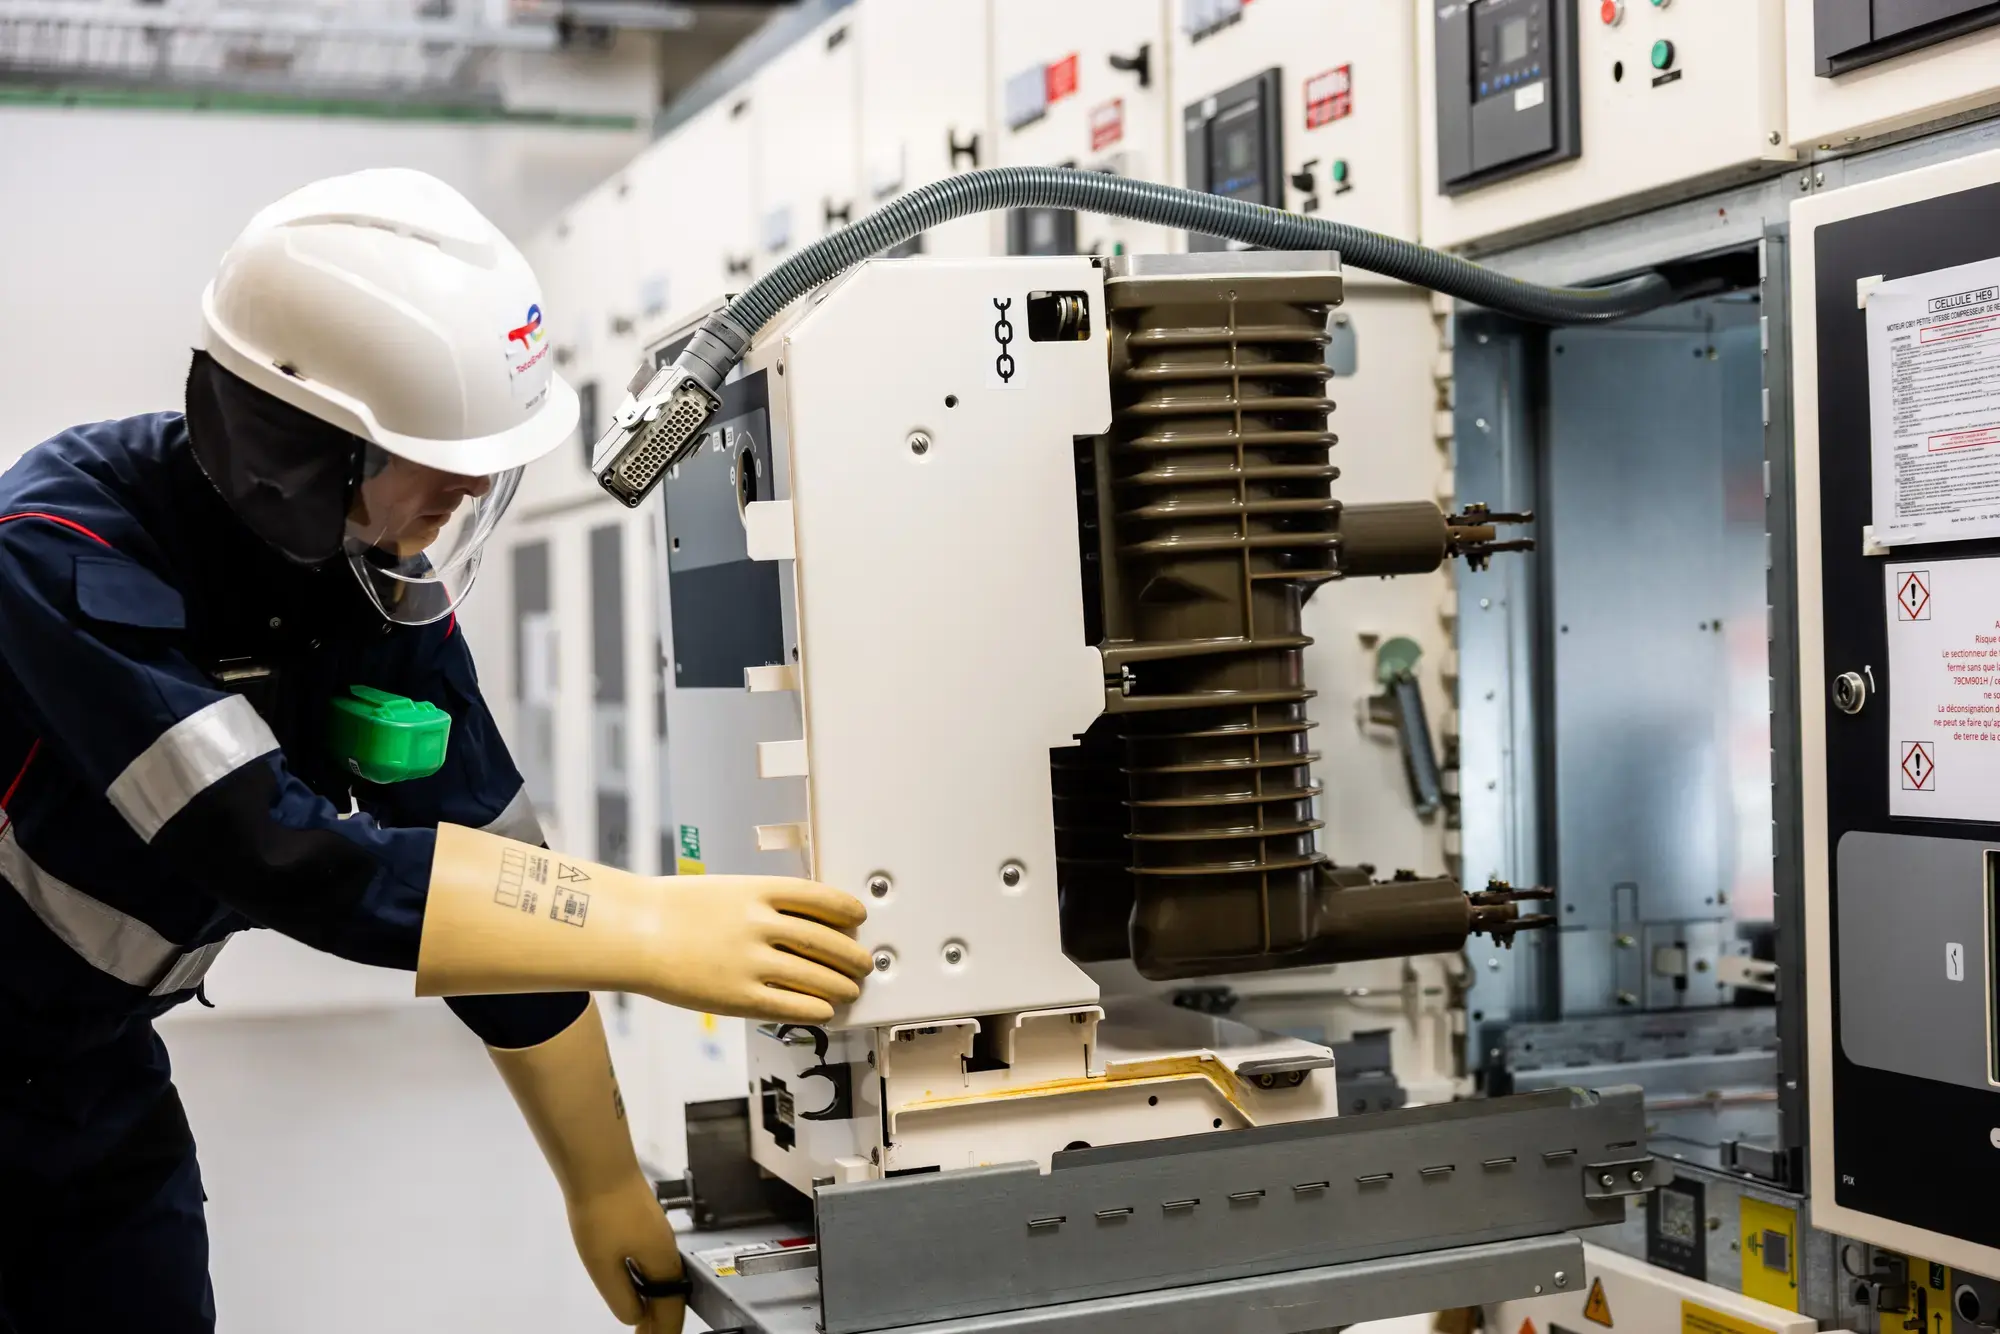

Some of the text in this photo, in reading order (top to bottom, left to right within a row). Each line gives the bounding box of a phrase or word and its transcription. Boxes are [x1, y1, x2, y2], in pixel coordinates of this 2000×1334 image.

[1934, 289, 1993, 310] CELLULE HE9
[1886, 322, 1905, 332] MOTEUR
[1916, 316, 1932, 326] PETITE
[1932, 312, 1950, 323] VITESSE
[1950, 306, 1985, 319] COMPRESSEUR
[1986, 304, 1993, 312] DE
[1975, 634, 1997, 645] Risque
[1942, 648, 1997, 658] Le sectionneur de
[1983, 664, 1995, 672] que
[1938, 703, 2000, 714] La déconsignation d
[1943, 718, 1957, 728] peut
[1967, 717, 1982, 727] faire
[1954, 732, 1962, 740] de
[1963, 732, 1979, 740] terre
[1980, 731, 1988, 740] de
[1990, 731, 1996, 740] la
[1843, 1174, 1855, 1186] PIX
